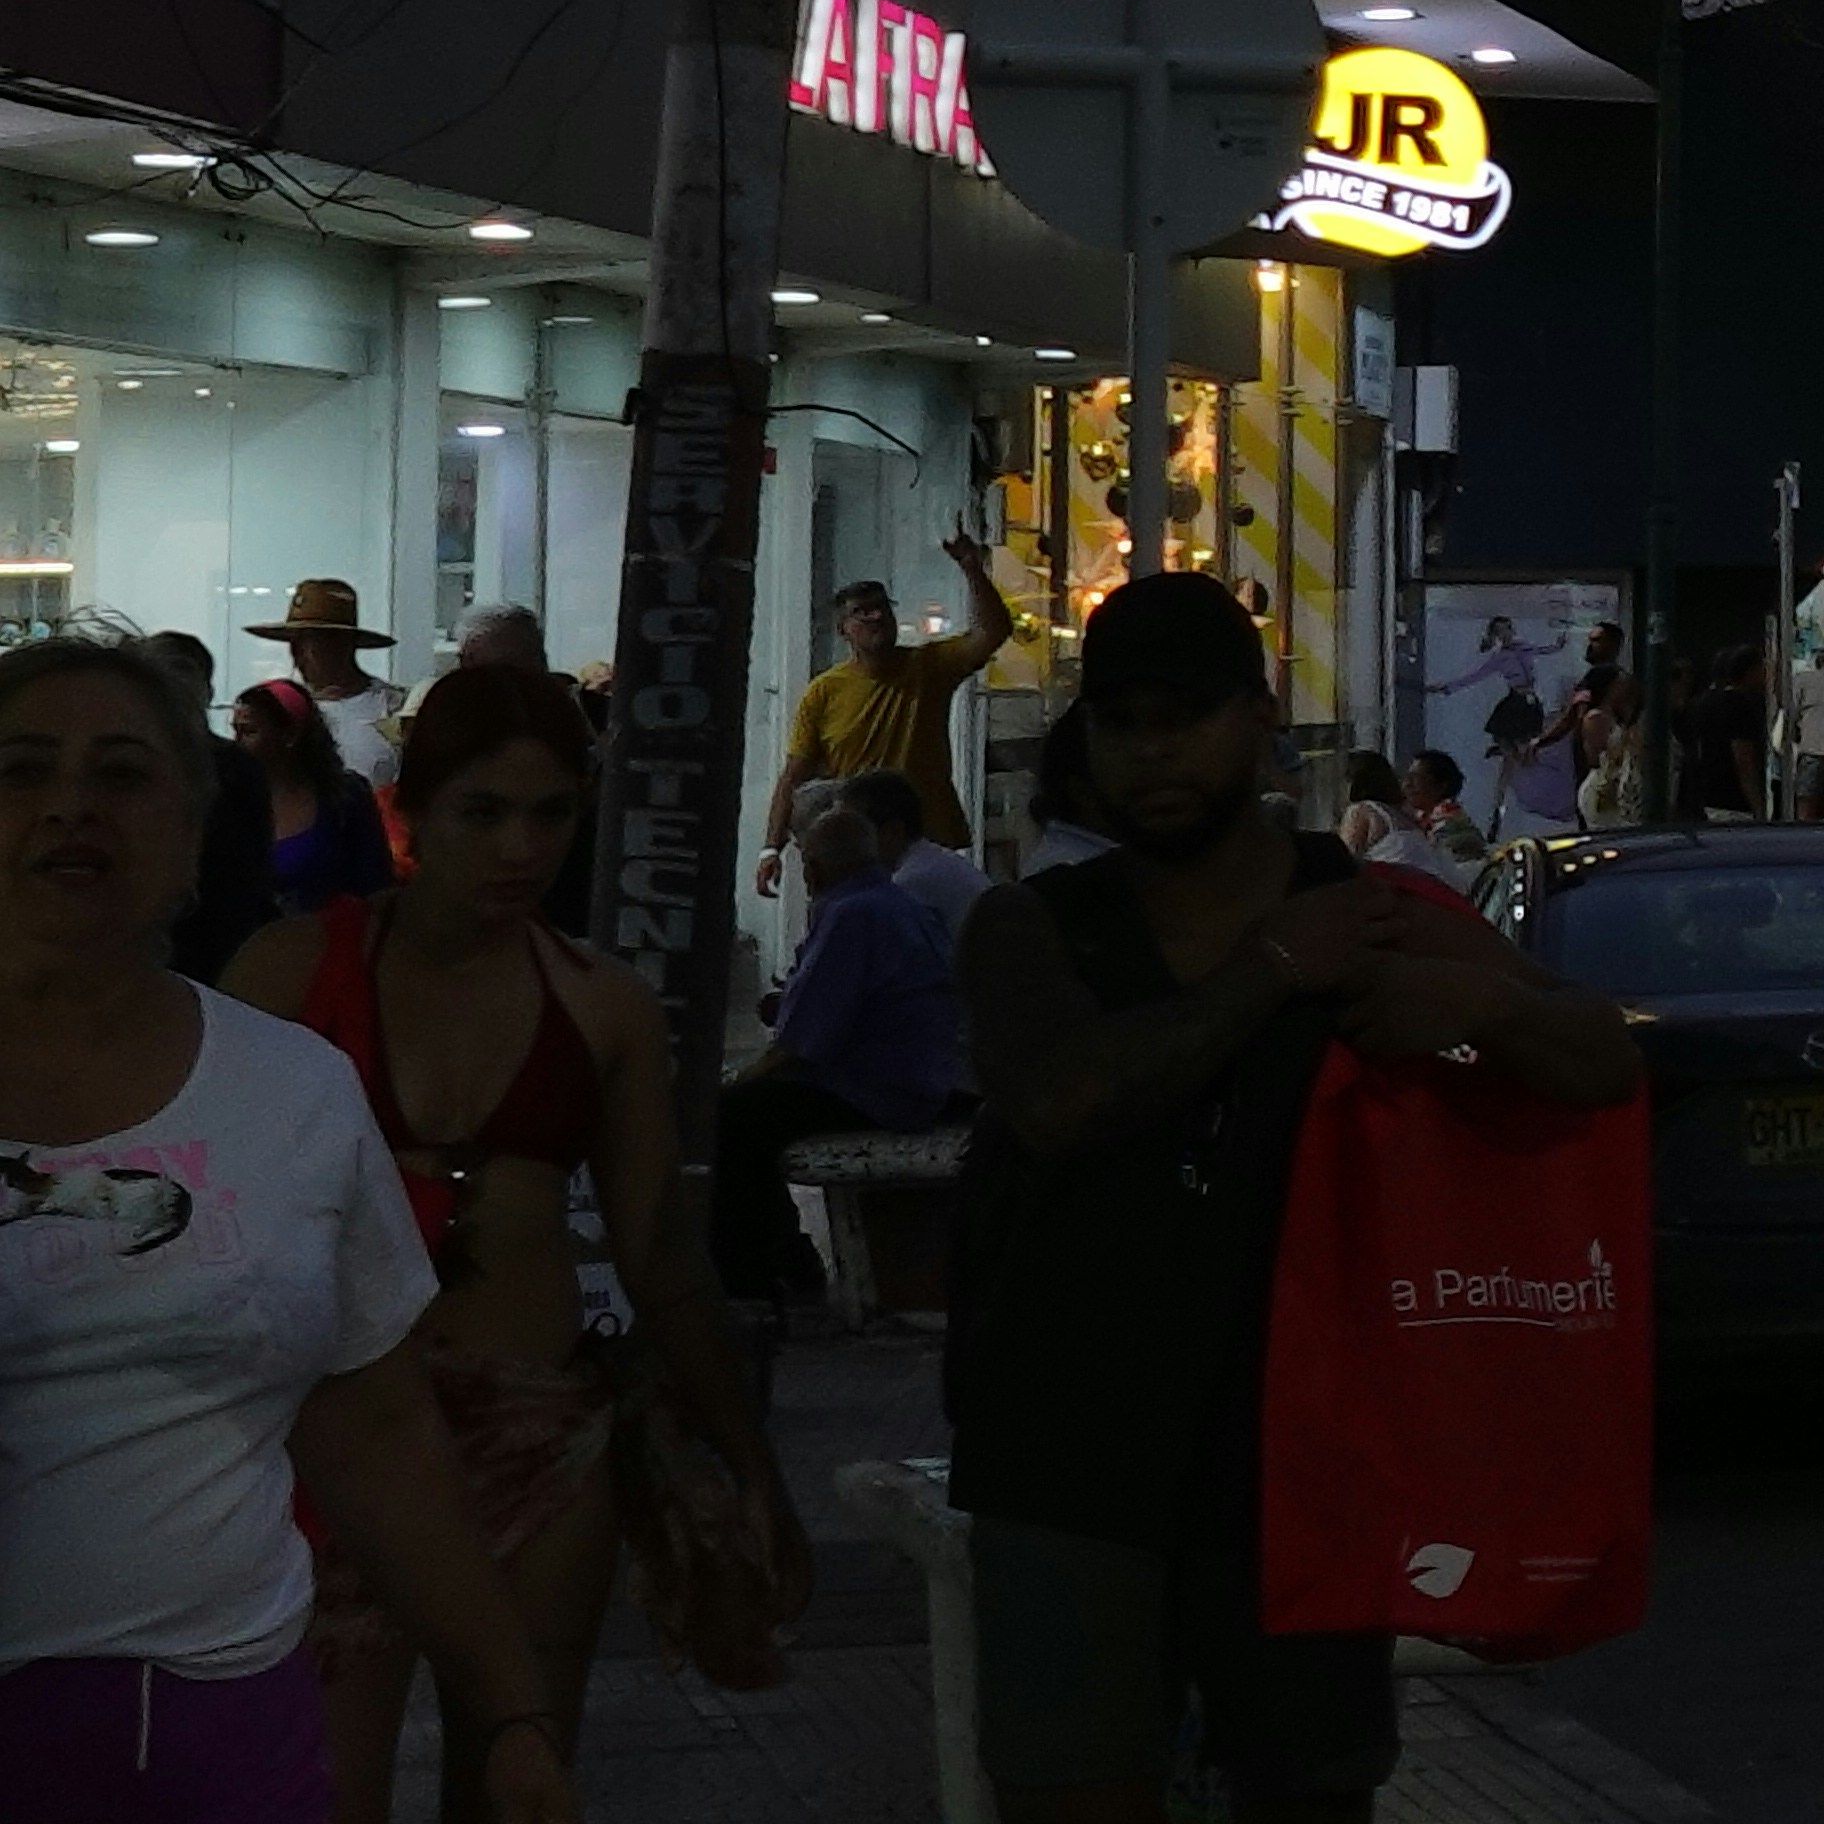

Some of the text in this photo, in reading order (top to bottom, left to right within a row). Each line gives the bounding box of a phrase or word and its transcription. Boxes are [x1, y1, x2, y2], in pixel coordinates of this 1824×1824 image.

[1315, 92, 1448, 167] JR
[1279, 169, 1471, 233] SINCE 1981
[617, 756, 705, 1074] TECNI
